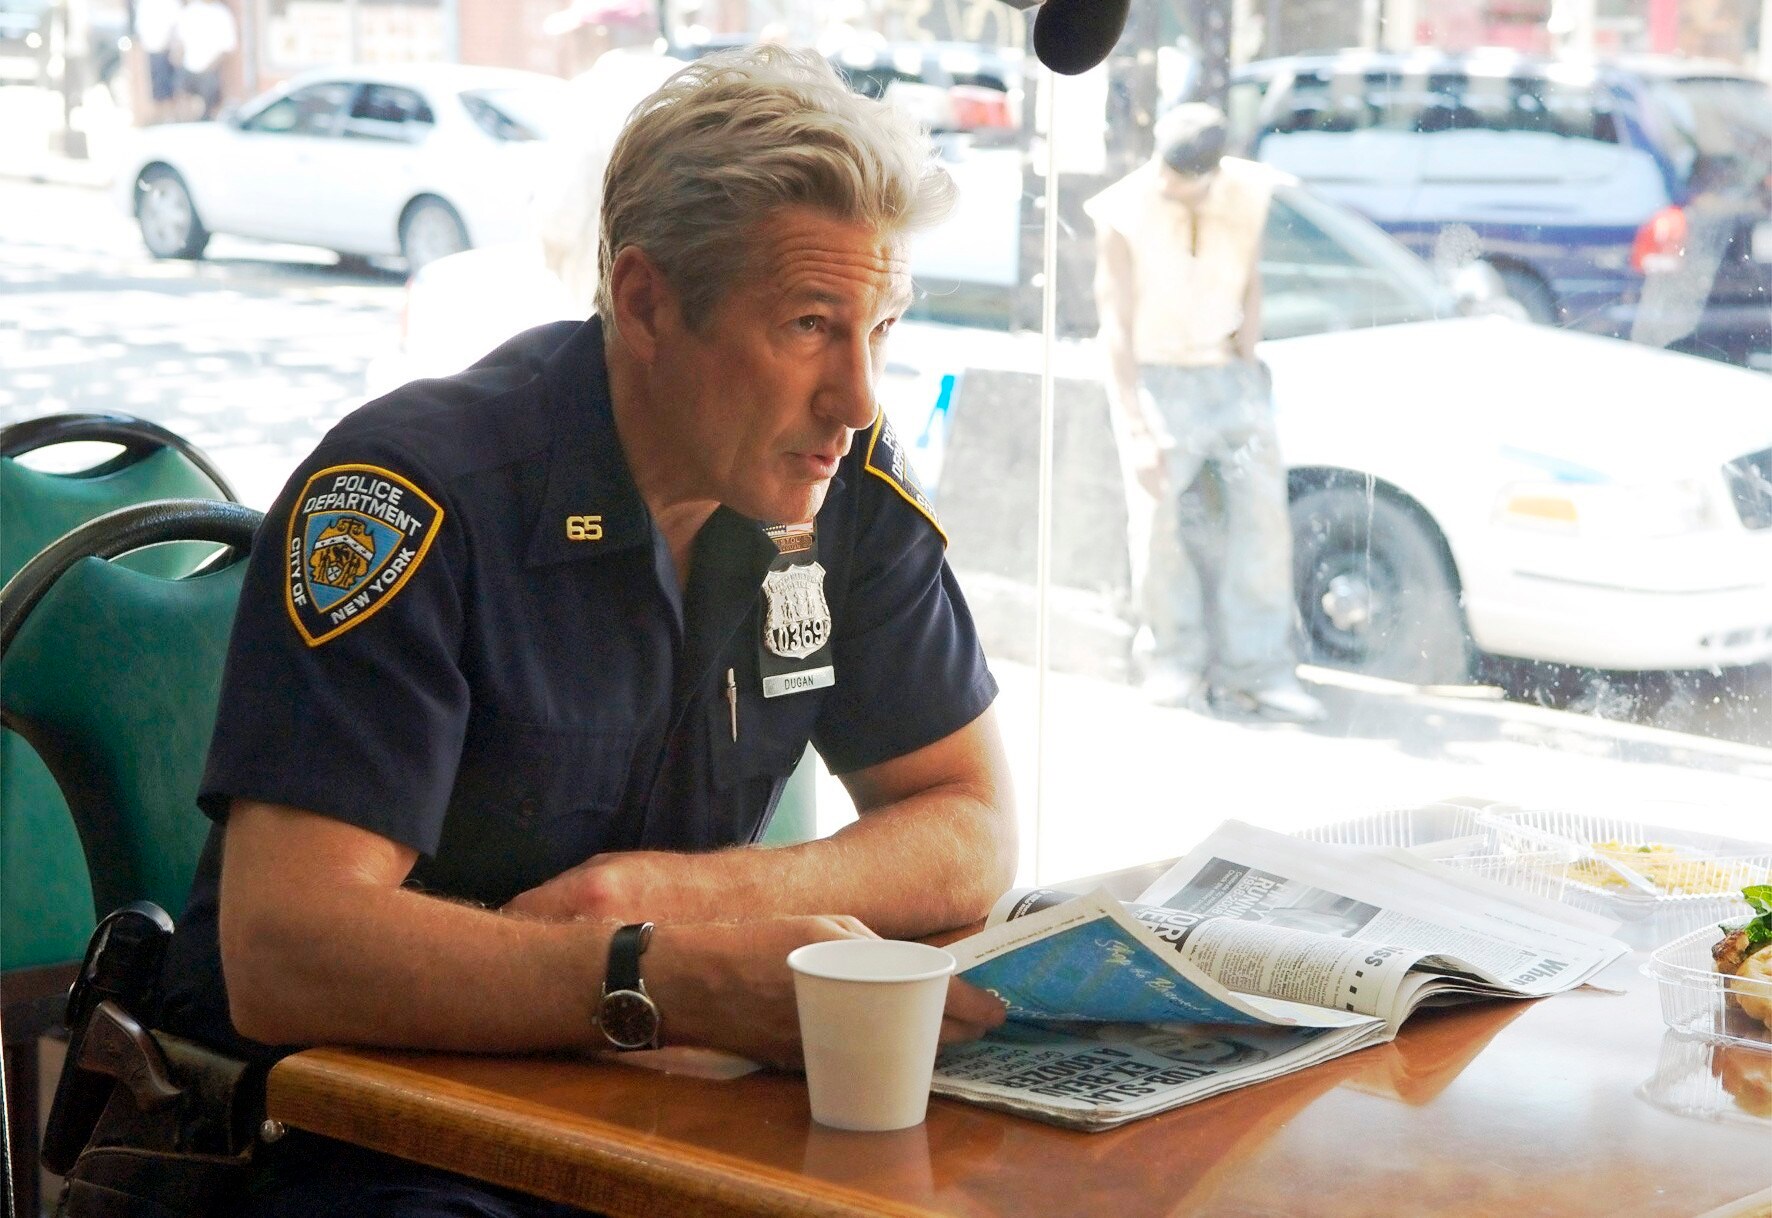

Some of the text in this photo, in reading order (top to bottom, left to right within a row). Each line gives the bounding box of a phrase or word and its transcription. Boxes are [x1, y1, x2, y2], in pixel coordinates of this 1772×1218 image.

[332, 475, 403, 505] POLICE
[303, 493, 422, 537] DEPARTMENT
[566, 515, 603, 541] 65
[291, 537, 309, 607] CITY OF
[330, 547, 416, 625] NEW YORK
[784, 675, 814, 690] DUGAN
[1508, 959, 1569, 986] When
